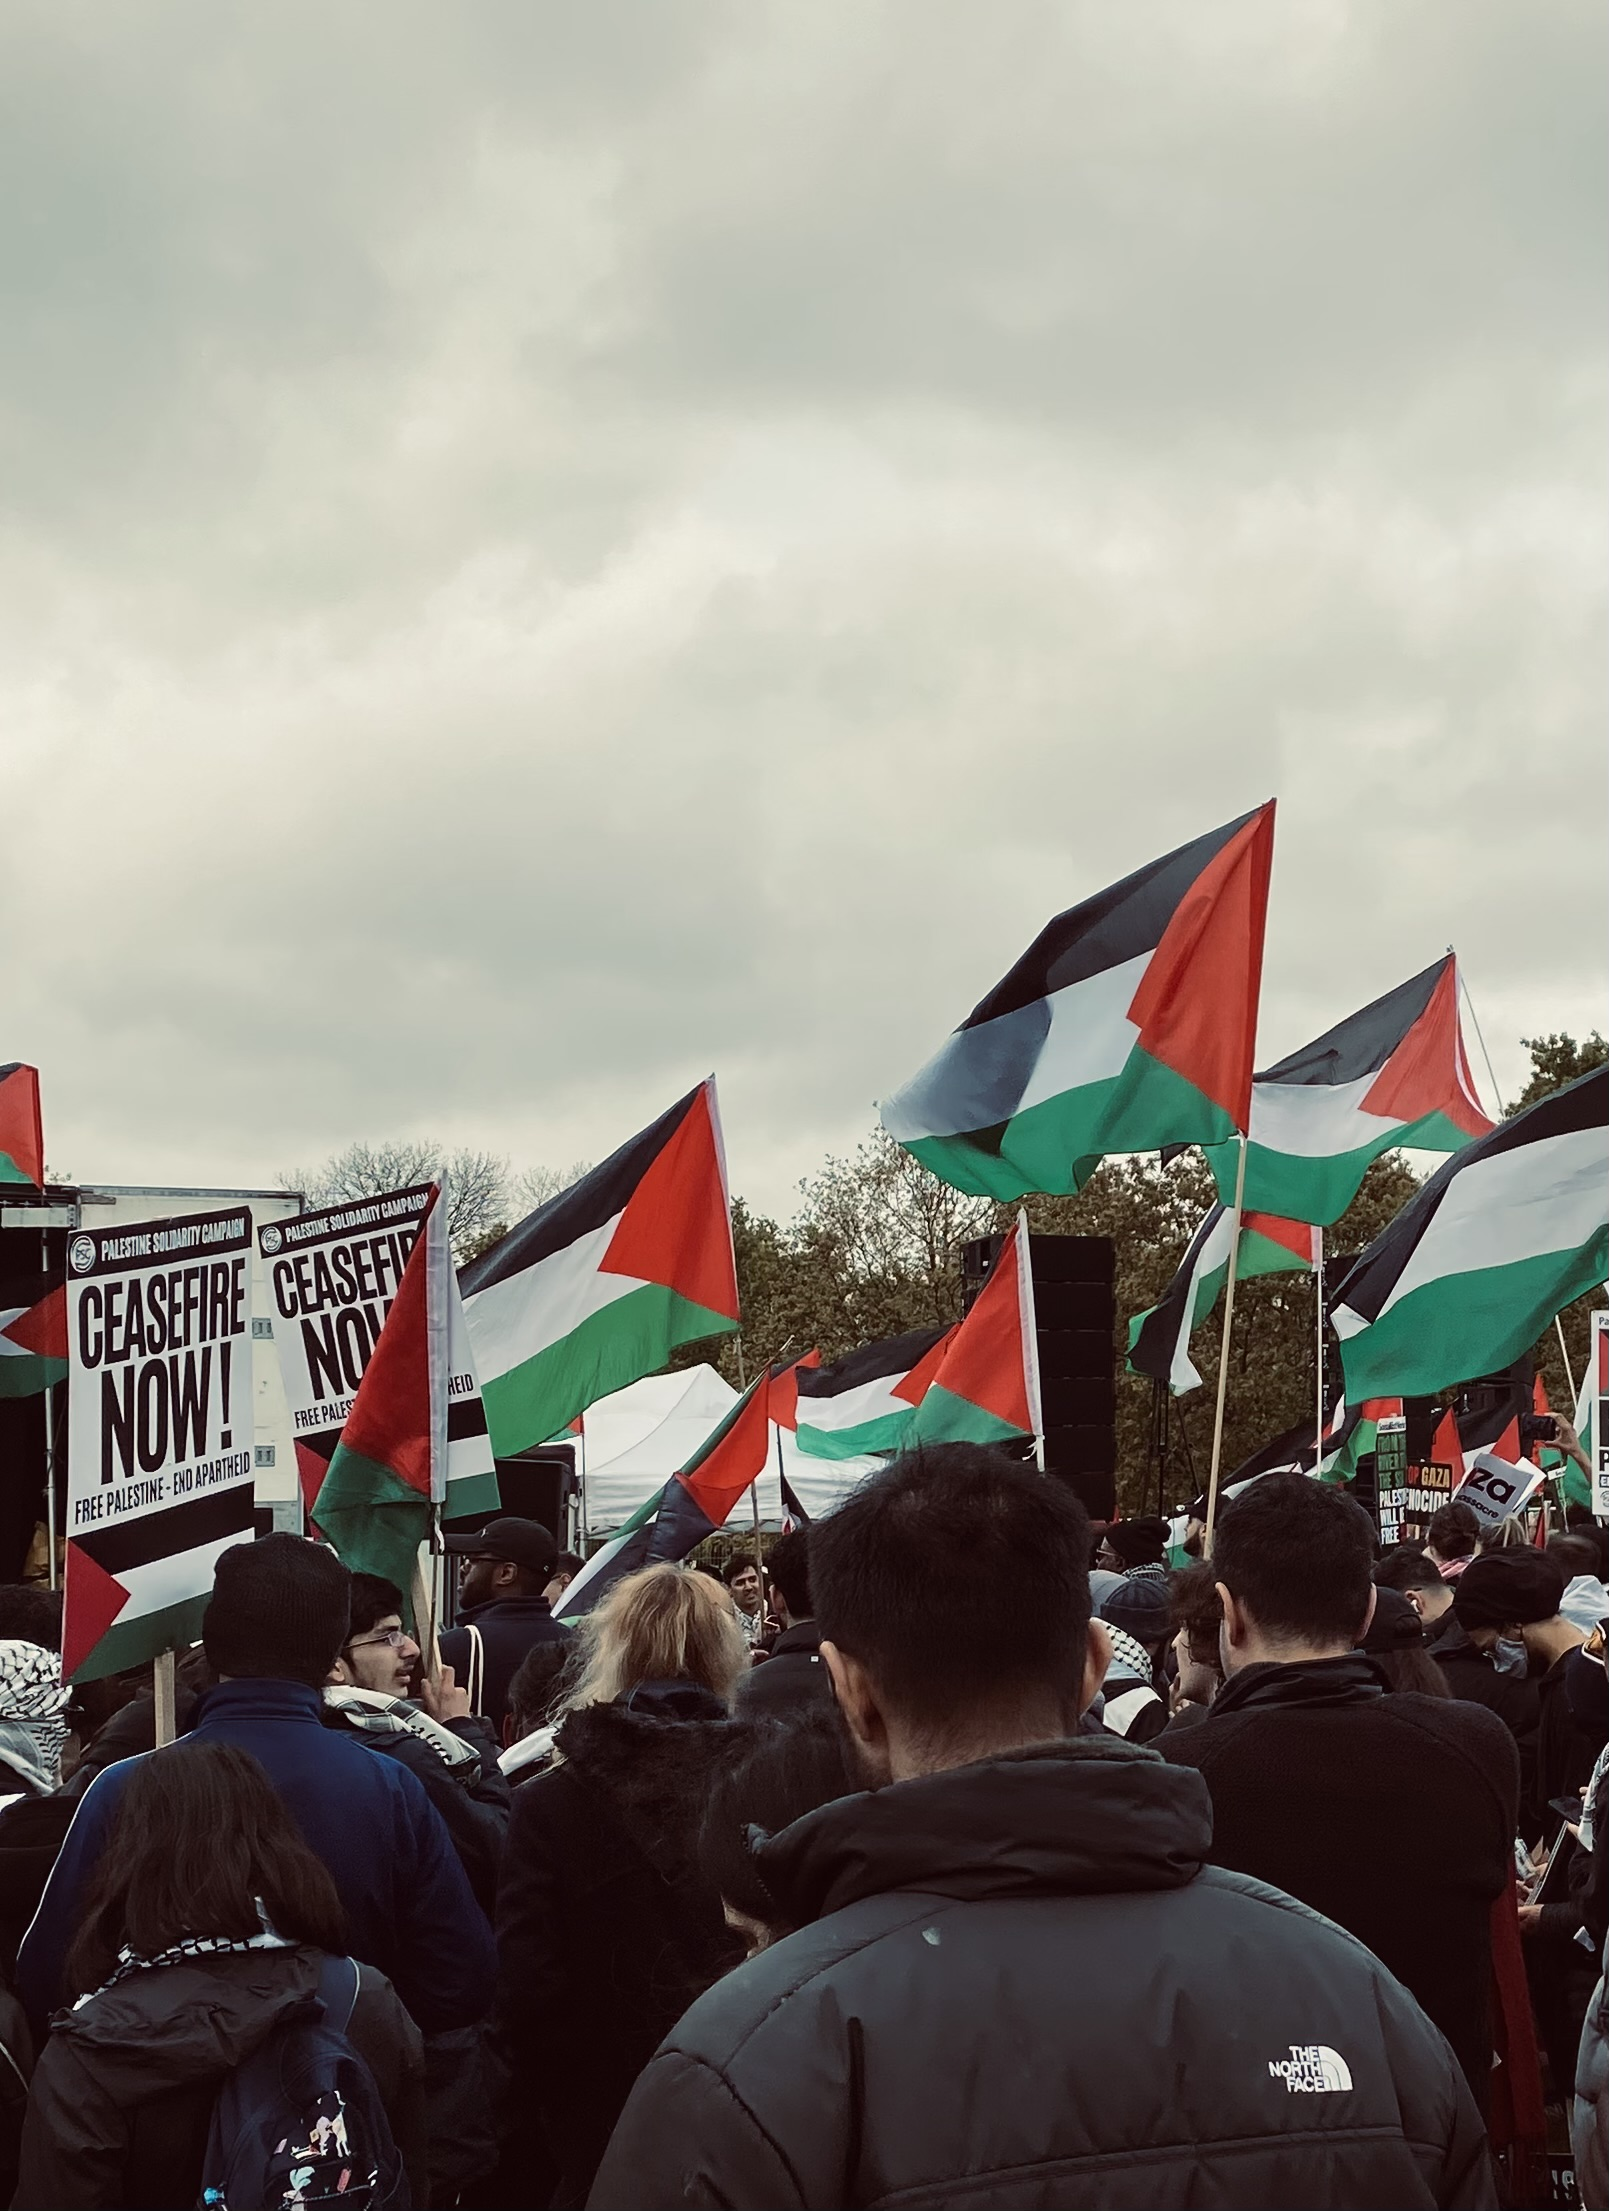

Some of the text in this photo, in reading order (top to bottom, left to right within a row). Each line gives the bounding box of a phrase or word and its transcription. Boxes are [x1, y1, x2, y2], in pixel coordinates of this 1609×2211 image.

[285, 1192, 429, 1243] PALESTINE SOLIDARITY CAMPAIGN
[101, 1217, 246, 1262] PALESTINE SOLIDARITY CAMPAIGN
[273, 1228, 418, 1319] CEASEFIR
[78, 1257, 246, 1370] CEASEFIRE
[101, 1341, 233, 1486] NOW!
[294, 1398, 356, 1430] FREE PALES
[75, 1494, 103, 1525] FREE
[106, 1476, 164, 1517] PALESTINE
[173, 1467, 193, 1496] END
[195, 1451, 251, 1489] APARTHEID
[1407, 1465, 1450, 1488] OP GAZA
[1467, 1466, 1517, 1505] za
[1406, 1488, 1450, 1513] NOCIDE
[1458, 1494, 1500, 1519] assacre
[1380, 1507, 1399, 1527] WILL
[1381, 1526, 1400, 1545] FREE
[1288, 2045, 1320, 2061] THE
[1268, 2060, 1322, 2077] NORTH
[1286, 2076, 1325, 2092] FACE
